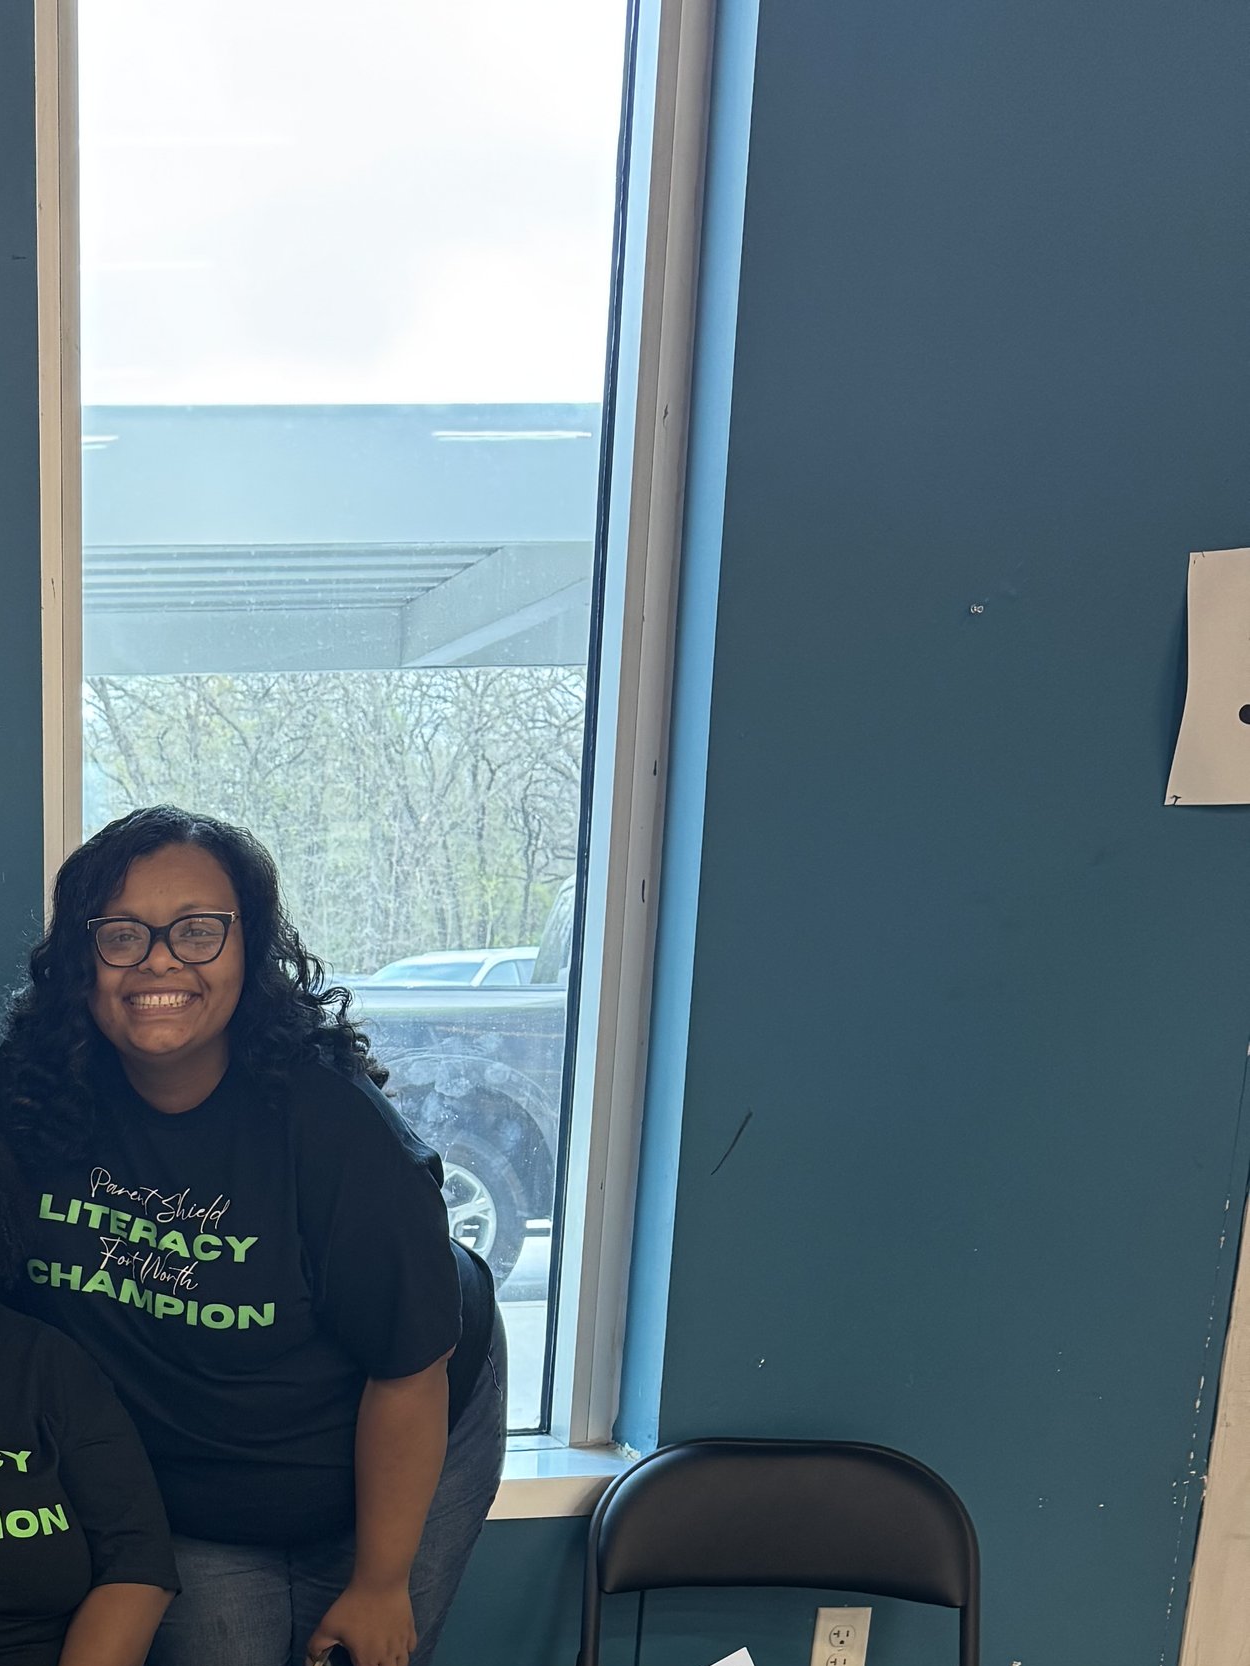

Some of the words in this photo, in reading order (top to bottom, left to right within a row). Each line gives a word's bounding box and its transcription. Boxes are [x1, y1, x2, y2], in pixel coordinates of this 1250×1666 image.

[39, 1193, 258, 1263] LITERACY
[90, 1167, 163, 1215] Parent
[156, 1188, 230, 1233] Shield
[26, 1259, 275, 1330] CHAMPION
[99, 1236, 144, 1279] Fort
[140, 1250, 198, 1295] Worth
